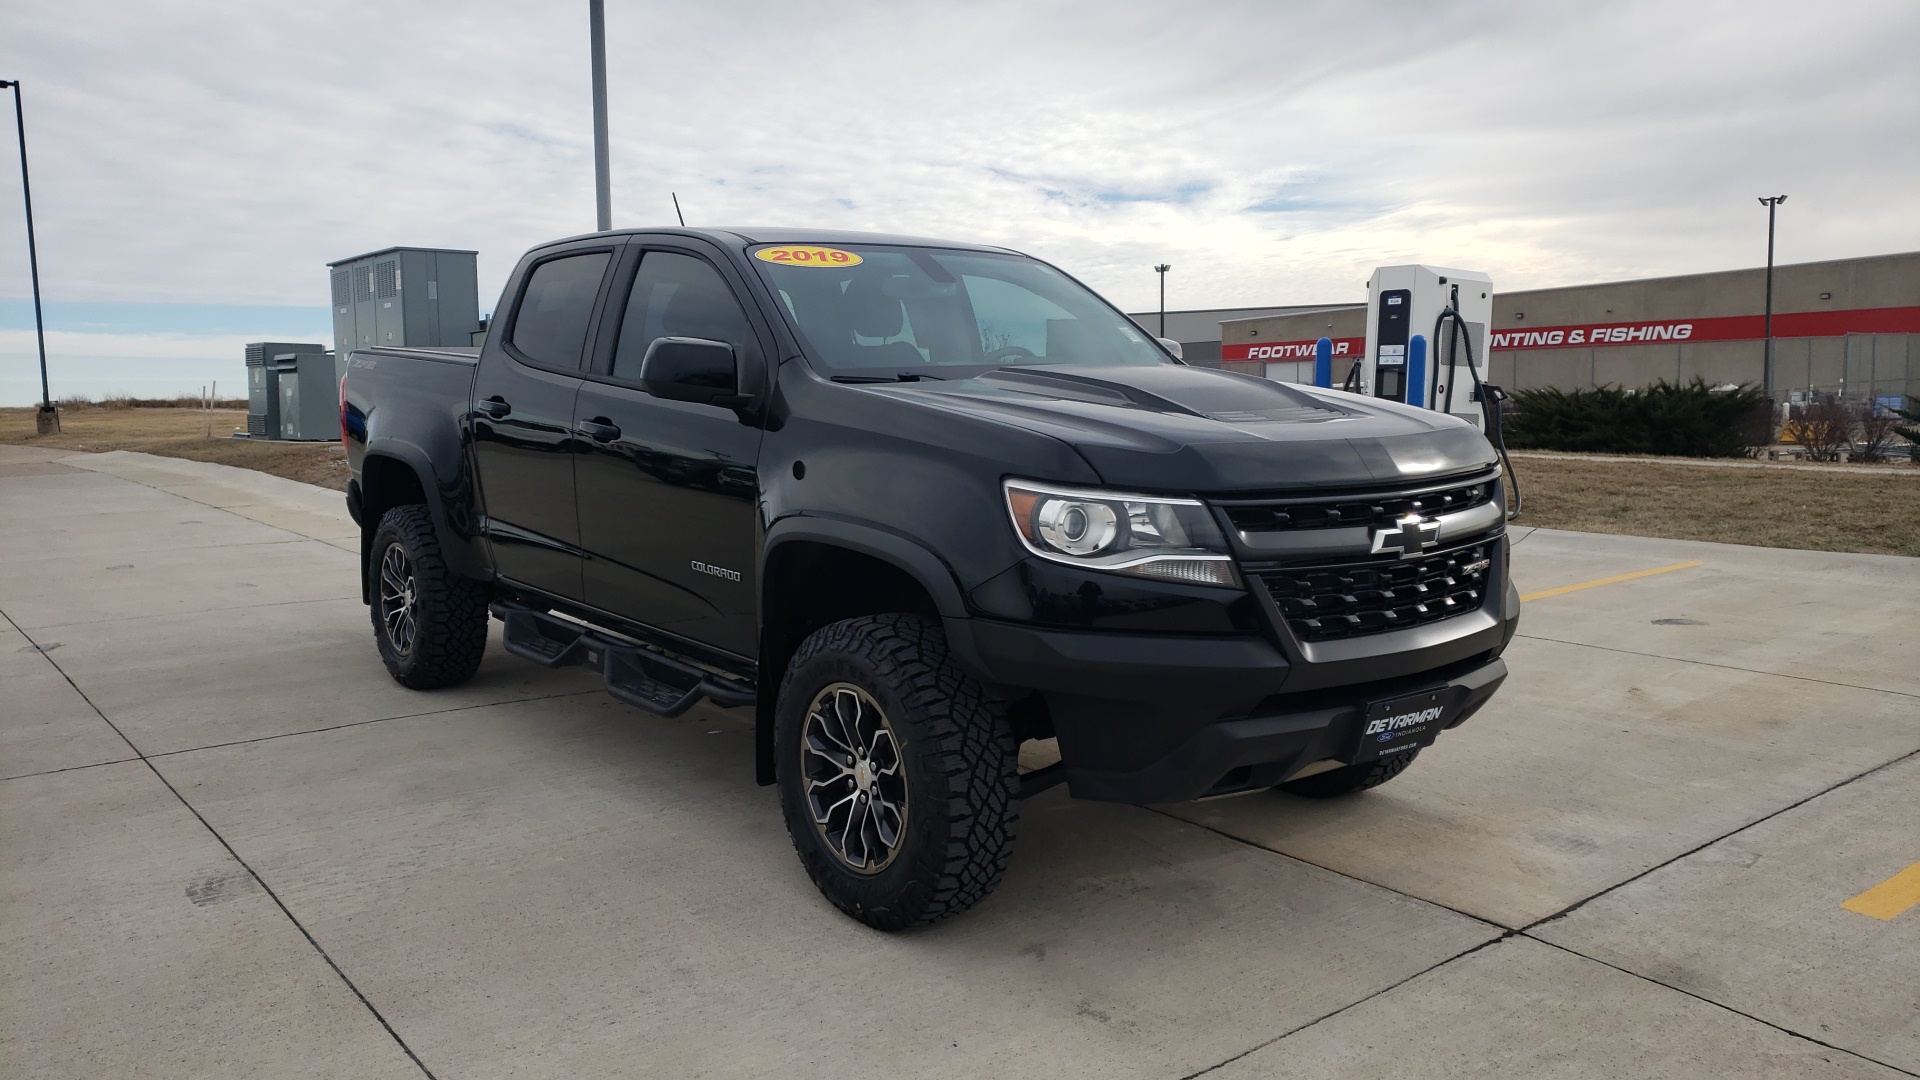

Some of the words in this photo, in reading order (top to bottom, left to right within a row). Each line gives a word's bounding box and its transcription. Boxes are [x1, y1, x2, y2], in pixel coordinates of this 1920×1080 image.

[770, 250, 851, 263] 2019
[1568, 329, 1586, 344] &
[1590, 323, 1693, 343] FISHING
[691, 560, 741, 582] COLORADO
[1365, 706, 1444, 735] DEYARMAN
[1395, 726, 1426, 738] INDIANOLA
